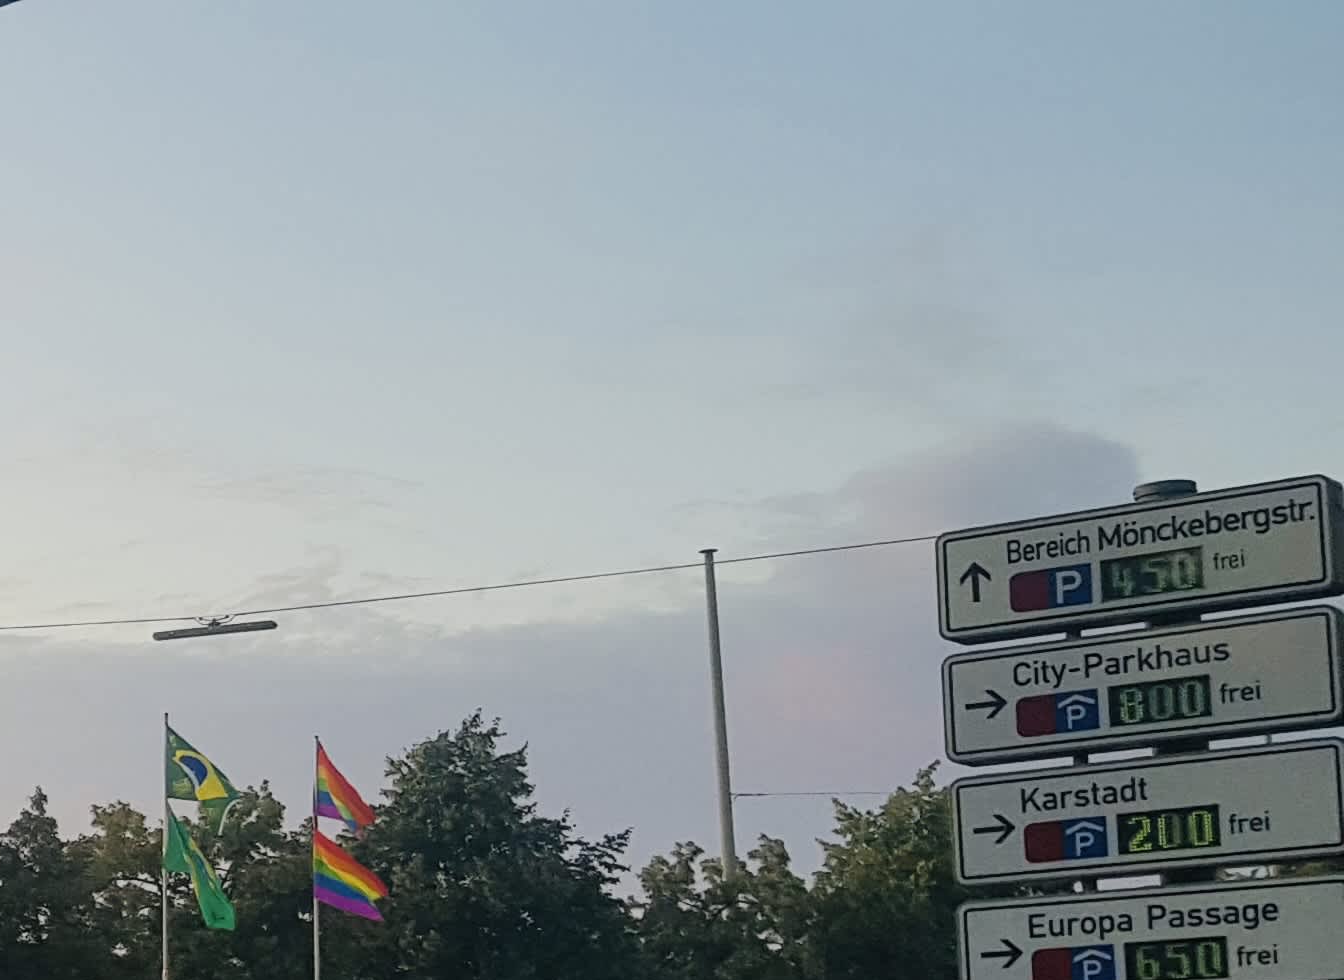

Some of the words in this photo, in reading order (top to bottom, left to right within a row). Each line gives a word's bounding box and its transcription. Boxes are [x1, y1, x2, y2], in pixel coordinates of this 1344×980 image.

[1006, 532, 1090, 565] Bereich
[1098, 498, 1316, 549] Mönckebergstr.
[1055, 570, 1082, 604] P
[1112, 553, 1200, 598] 450
[1213, 548, 1246, 571] frei
[1013, 641, 1230, 689] City-Parkhaus
[1065, 703, 1087, 730] P
[1119, 679, 1205, 724] 800
[1220, 680, 1262, 704] frei
[1020, 776, 1148, 814] Karstadt
[1074, 830, 1096, 857] P
[1127, 810, 1214, 853] 200
[1229, 810, 1271, 835] frei
[1028, 911, 1134, 940] Europa
[1147, 902, 1280, 932] Passage
[1135, 940, 1223, 980] 650
[1237, 944, 1279, 968] frei
